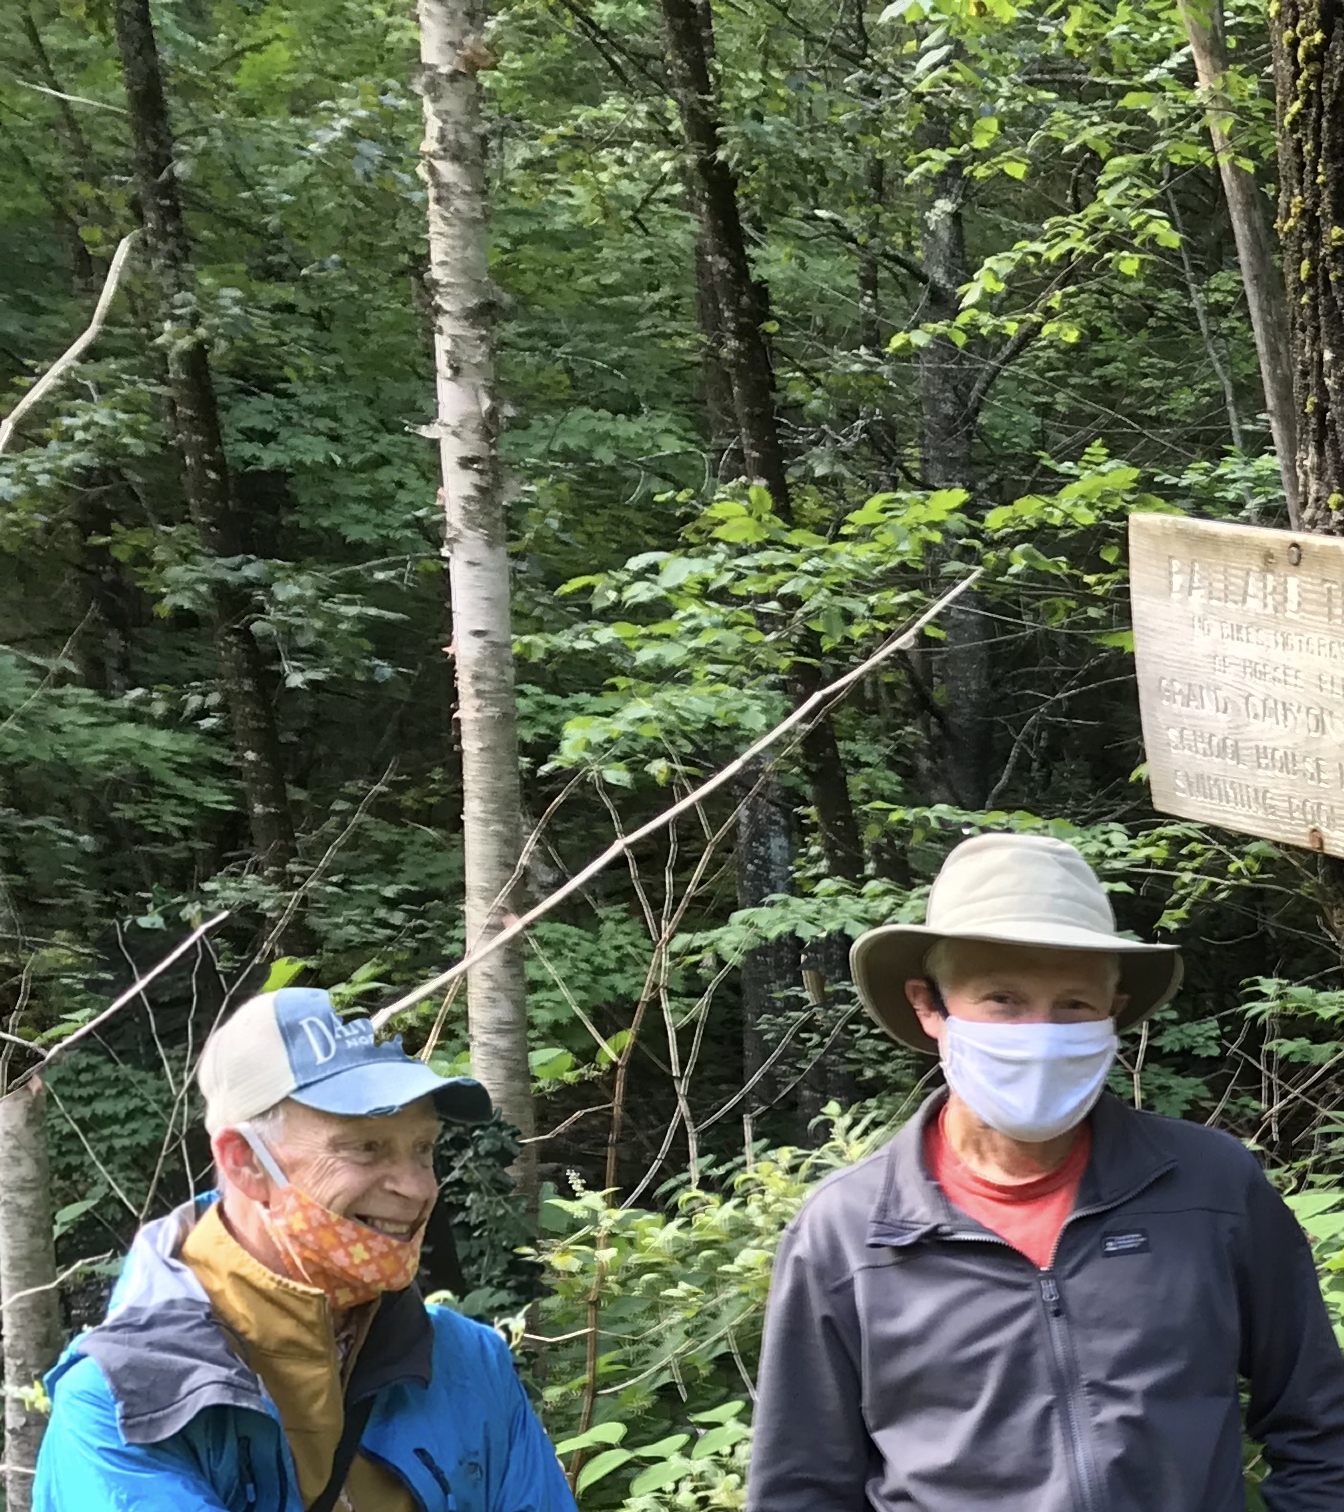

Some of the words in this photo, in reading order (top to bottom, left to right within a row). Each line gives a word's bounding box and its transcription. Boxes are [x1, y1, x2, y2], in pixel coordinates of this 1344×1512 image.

[1168, 555, 1302, 620] BALLARD
[1158, 676, 1229, 717] GRAND
[1245, 692, 1337, 742] CANYON
[1167, 726, 1248, 770] SCHOOL
[1254, 744, 1331, 789] HOUSE
[1288, 796, 1344, 836] POOL
